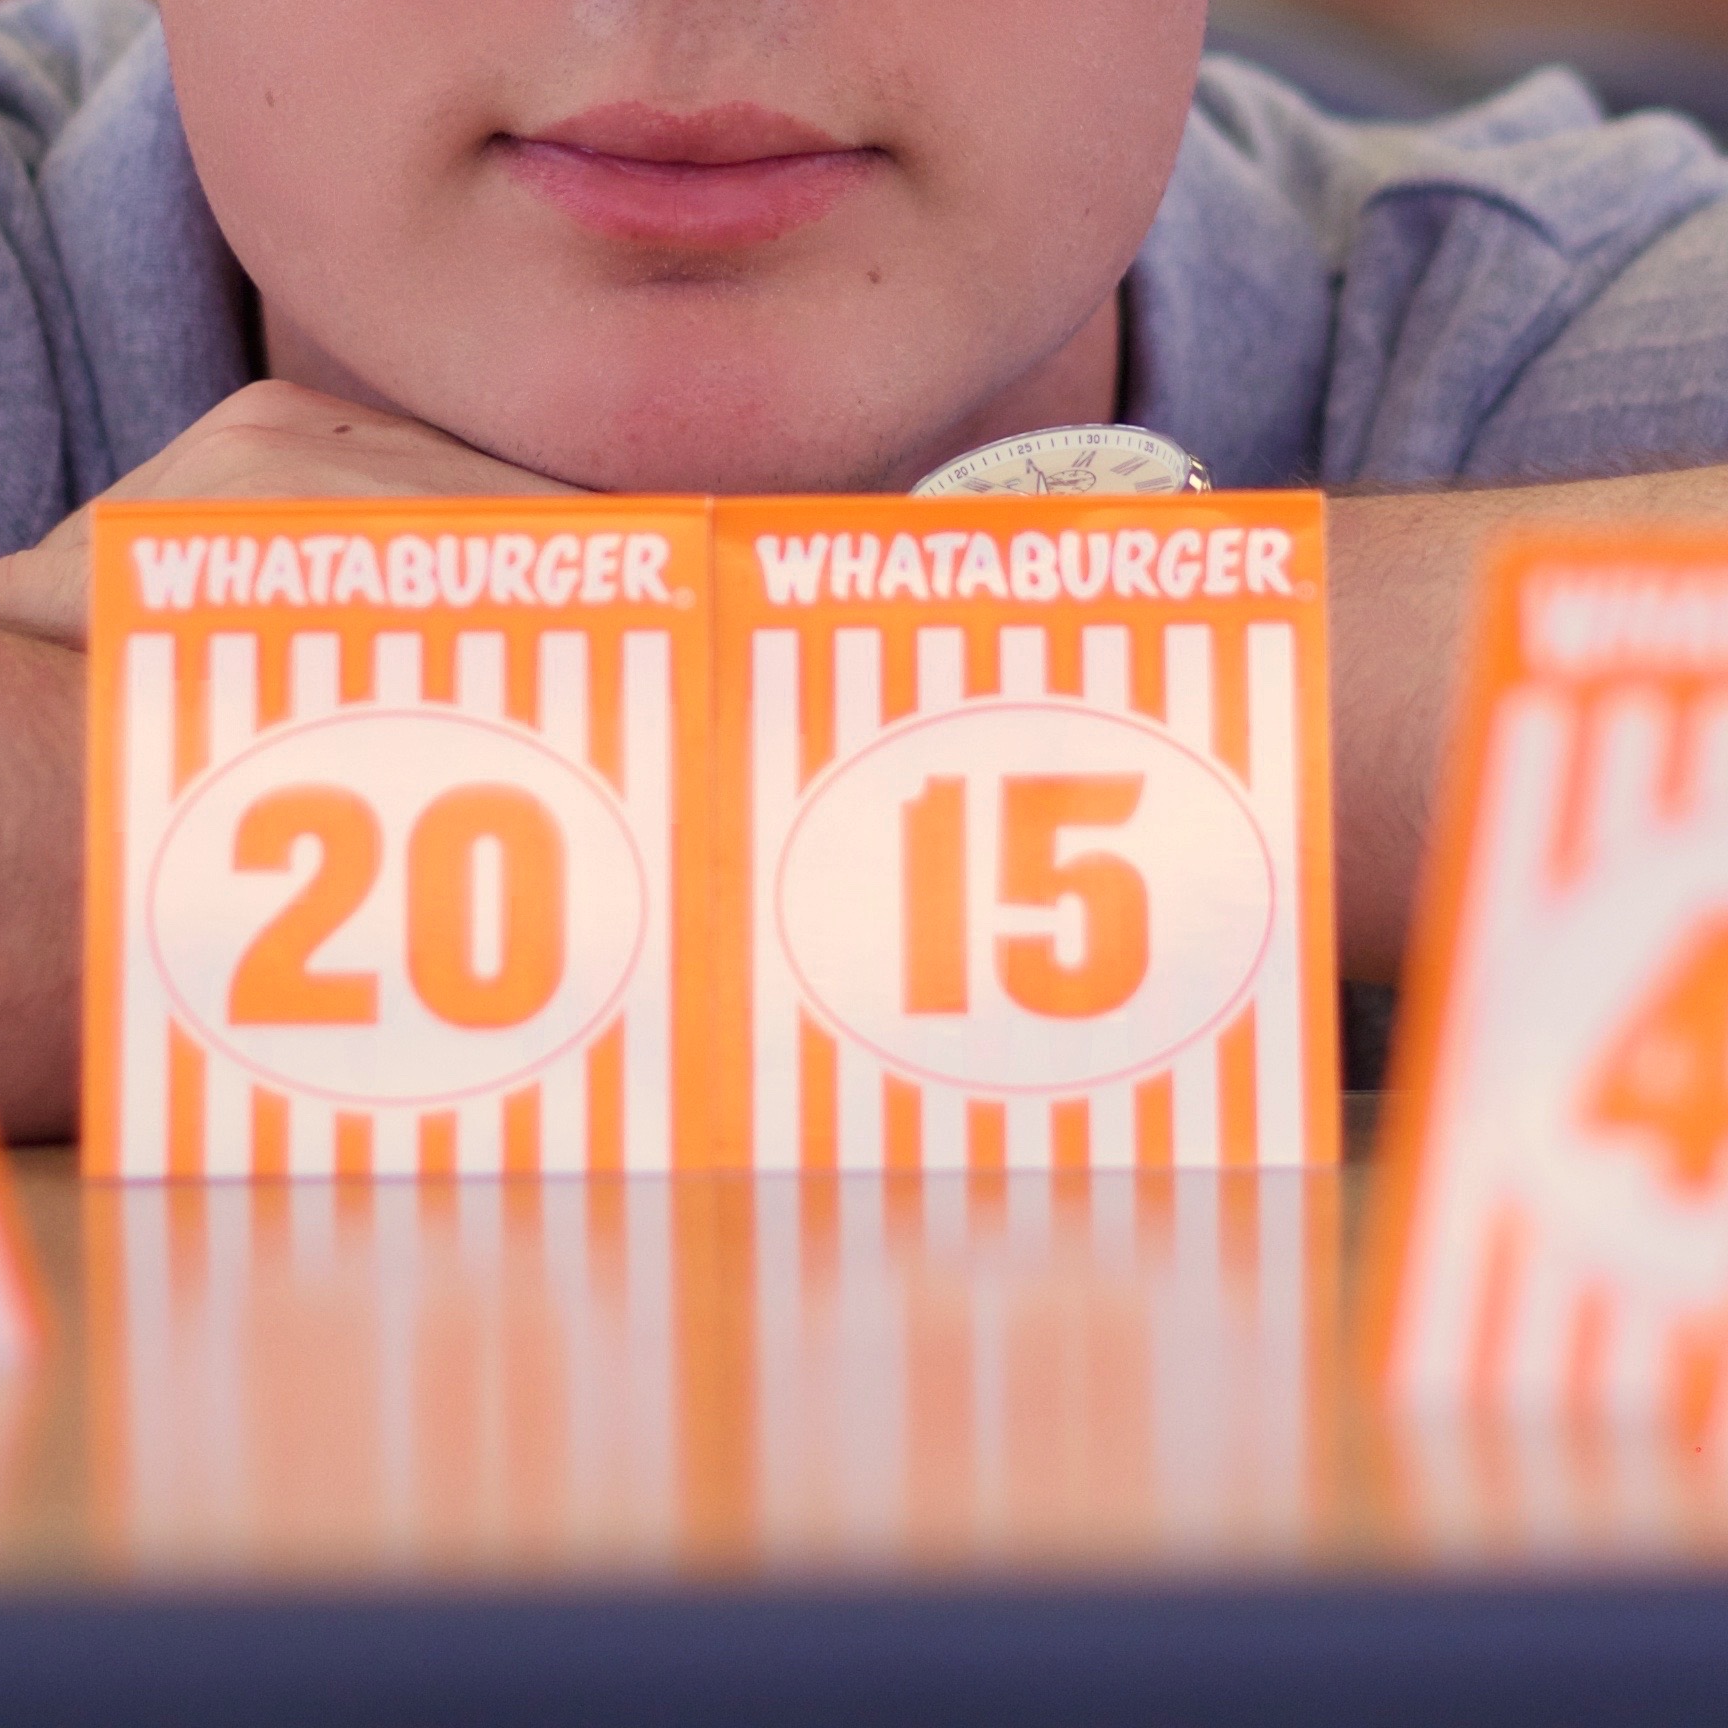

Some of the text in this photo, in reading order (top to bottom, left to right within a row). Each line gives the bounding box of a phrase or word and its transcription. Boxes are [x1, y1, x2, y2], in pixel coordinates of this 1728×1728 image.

[954, 466, 968, 480] 20
[1017, 442, 1032, 455] 25
[1086, 434, 1100, 445] 30
[131, 533, 672, 610] WHATABURGER
[755, 527, 1293, 605] WHATABURGER
[226, 778, 569, 1031] 20
[901, 772, 1151, 1020] 15
